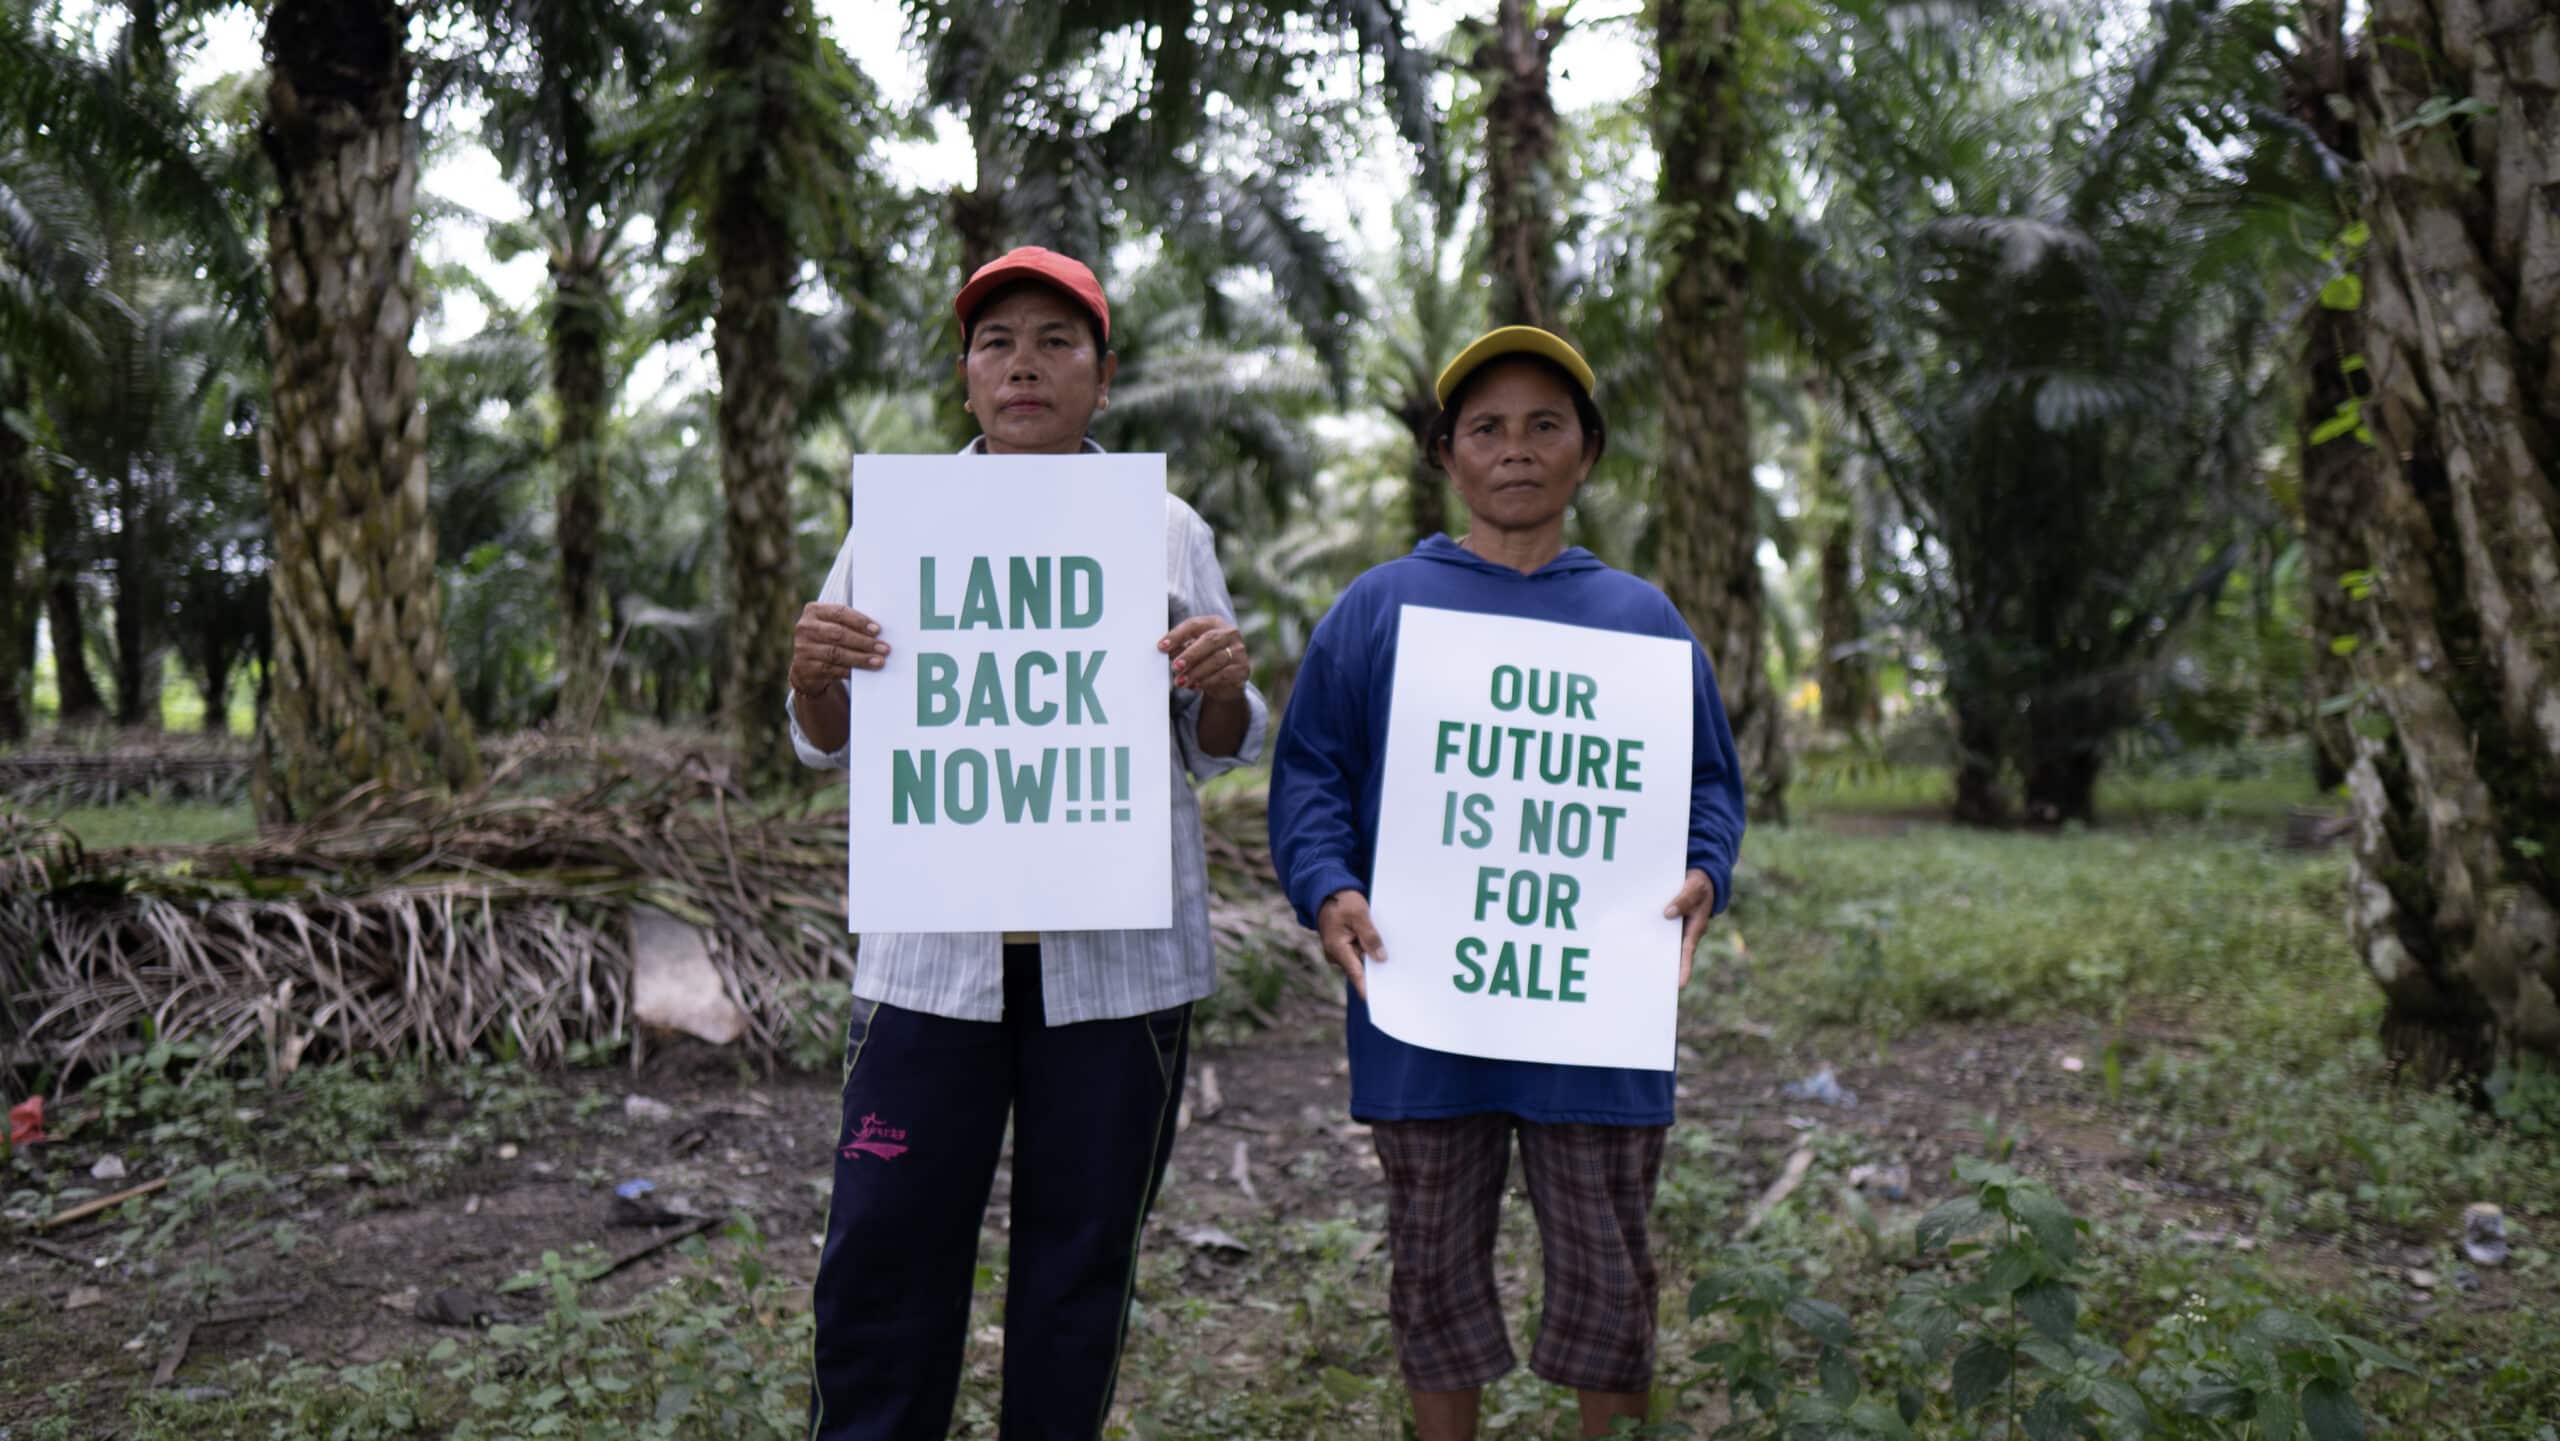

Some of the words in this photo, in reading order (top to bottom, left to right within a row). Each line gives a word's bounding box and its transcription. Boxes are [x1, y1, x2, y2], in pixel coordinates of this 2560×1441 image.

[919, 556, 1103, 631] LAND
[916, 650, 1108, 727] BACK
[1490, 664, 1598, 721] OUR
[892, 746, 1131, 825] NOW!!!
[1434, 720, 1645, 792] FUTURE
[1442, 791, 1495, 849] IS
[1519, 798, 1627, 861] NOT
[1473, 866, 1581, 931] FOR
[1452, 936, 1591, 1003] SALE
